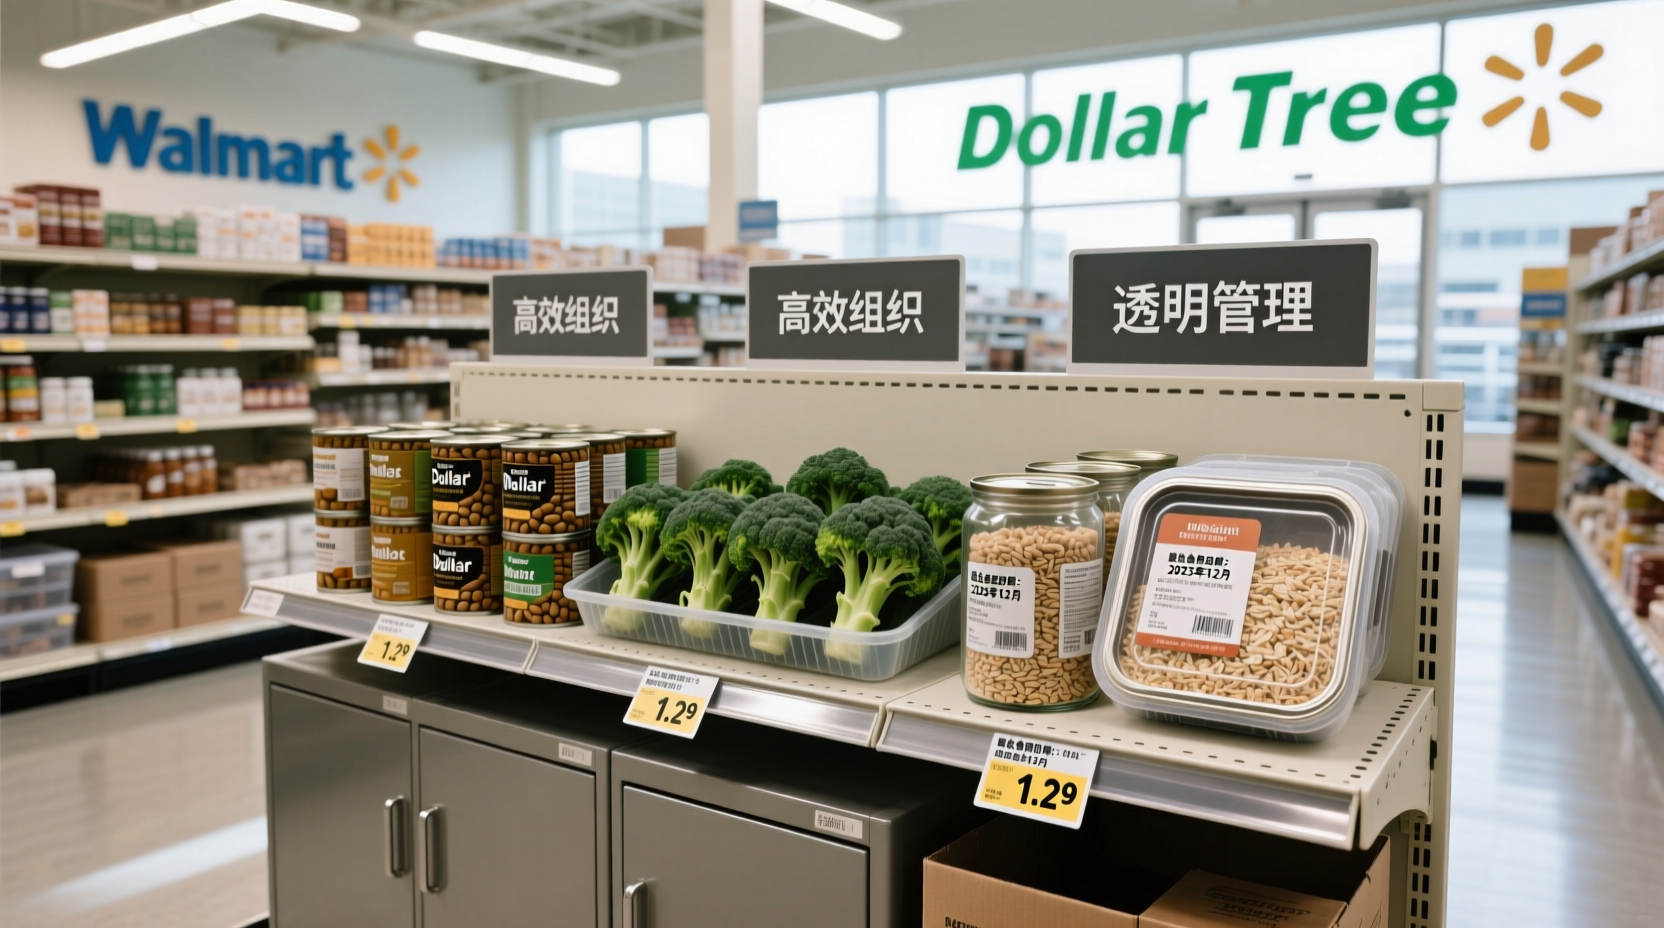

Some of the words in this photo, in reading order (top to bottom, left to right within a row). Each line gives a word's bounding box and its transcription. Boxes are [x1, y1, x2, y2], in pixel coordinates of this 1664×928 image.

[957, 93, 1209, 171] Dollar
[1231, 71, 1459, 150] Tree
[82, 99, 355, 191] Walmart
[512, 295, 620, 336] 高效组织
[776, 289, 925, 336] 高效组织
[1112, 280, 1315, 336] 透明管理
[655, 696, 698, 725] 1.29
[1017, 773, 1078, 810] 1.29
